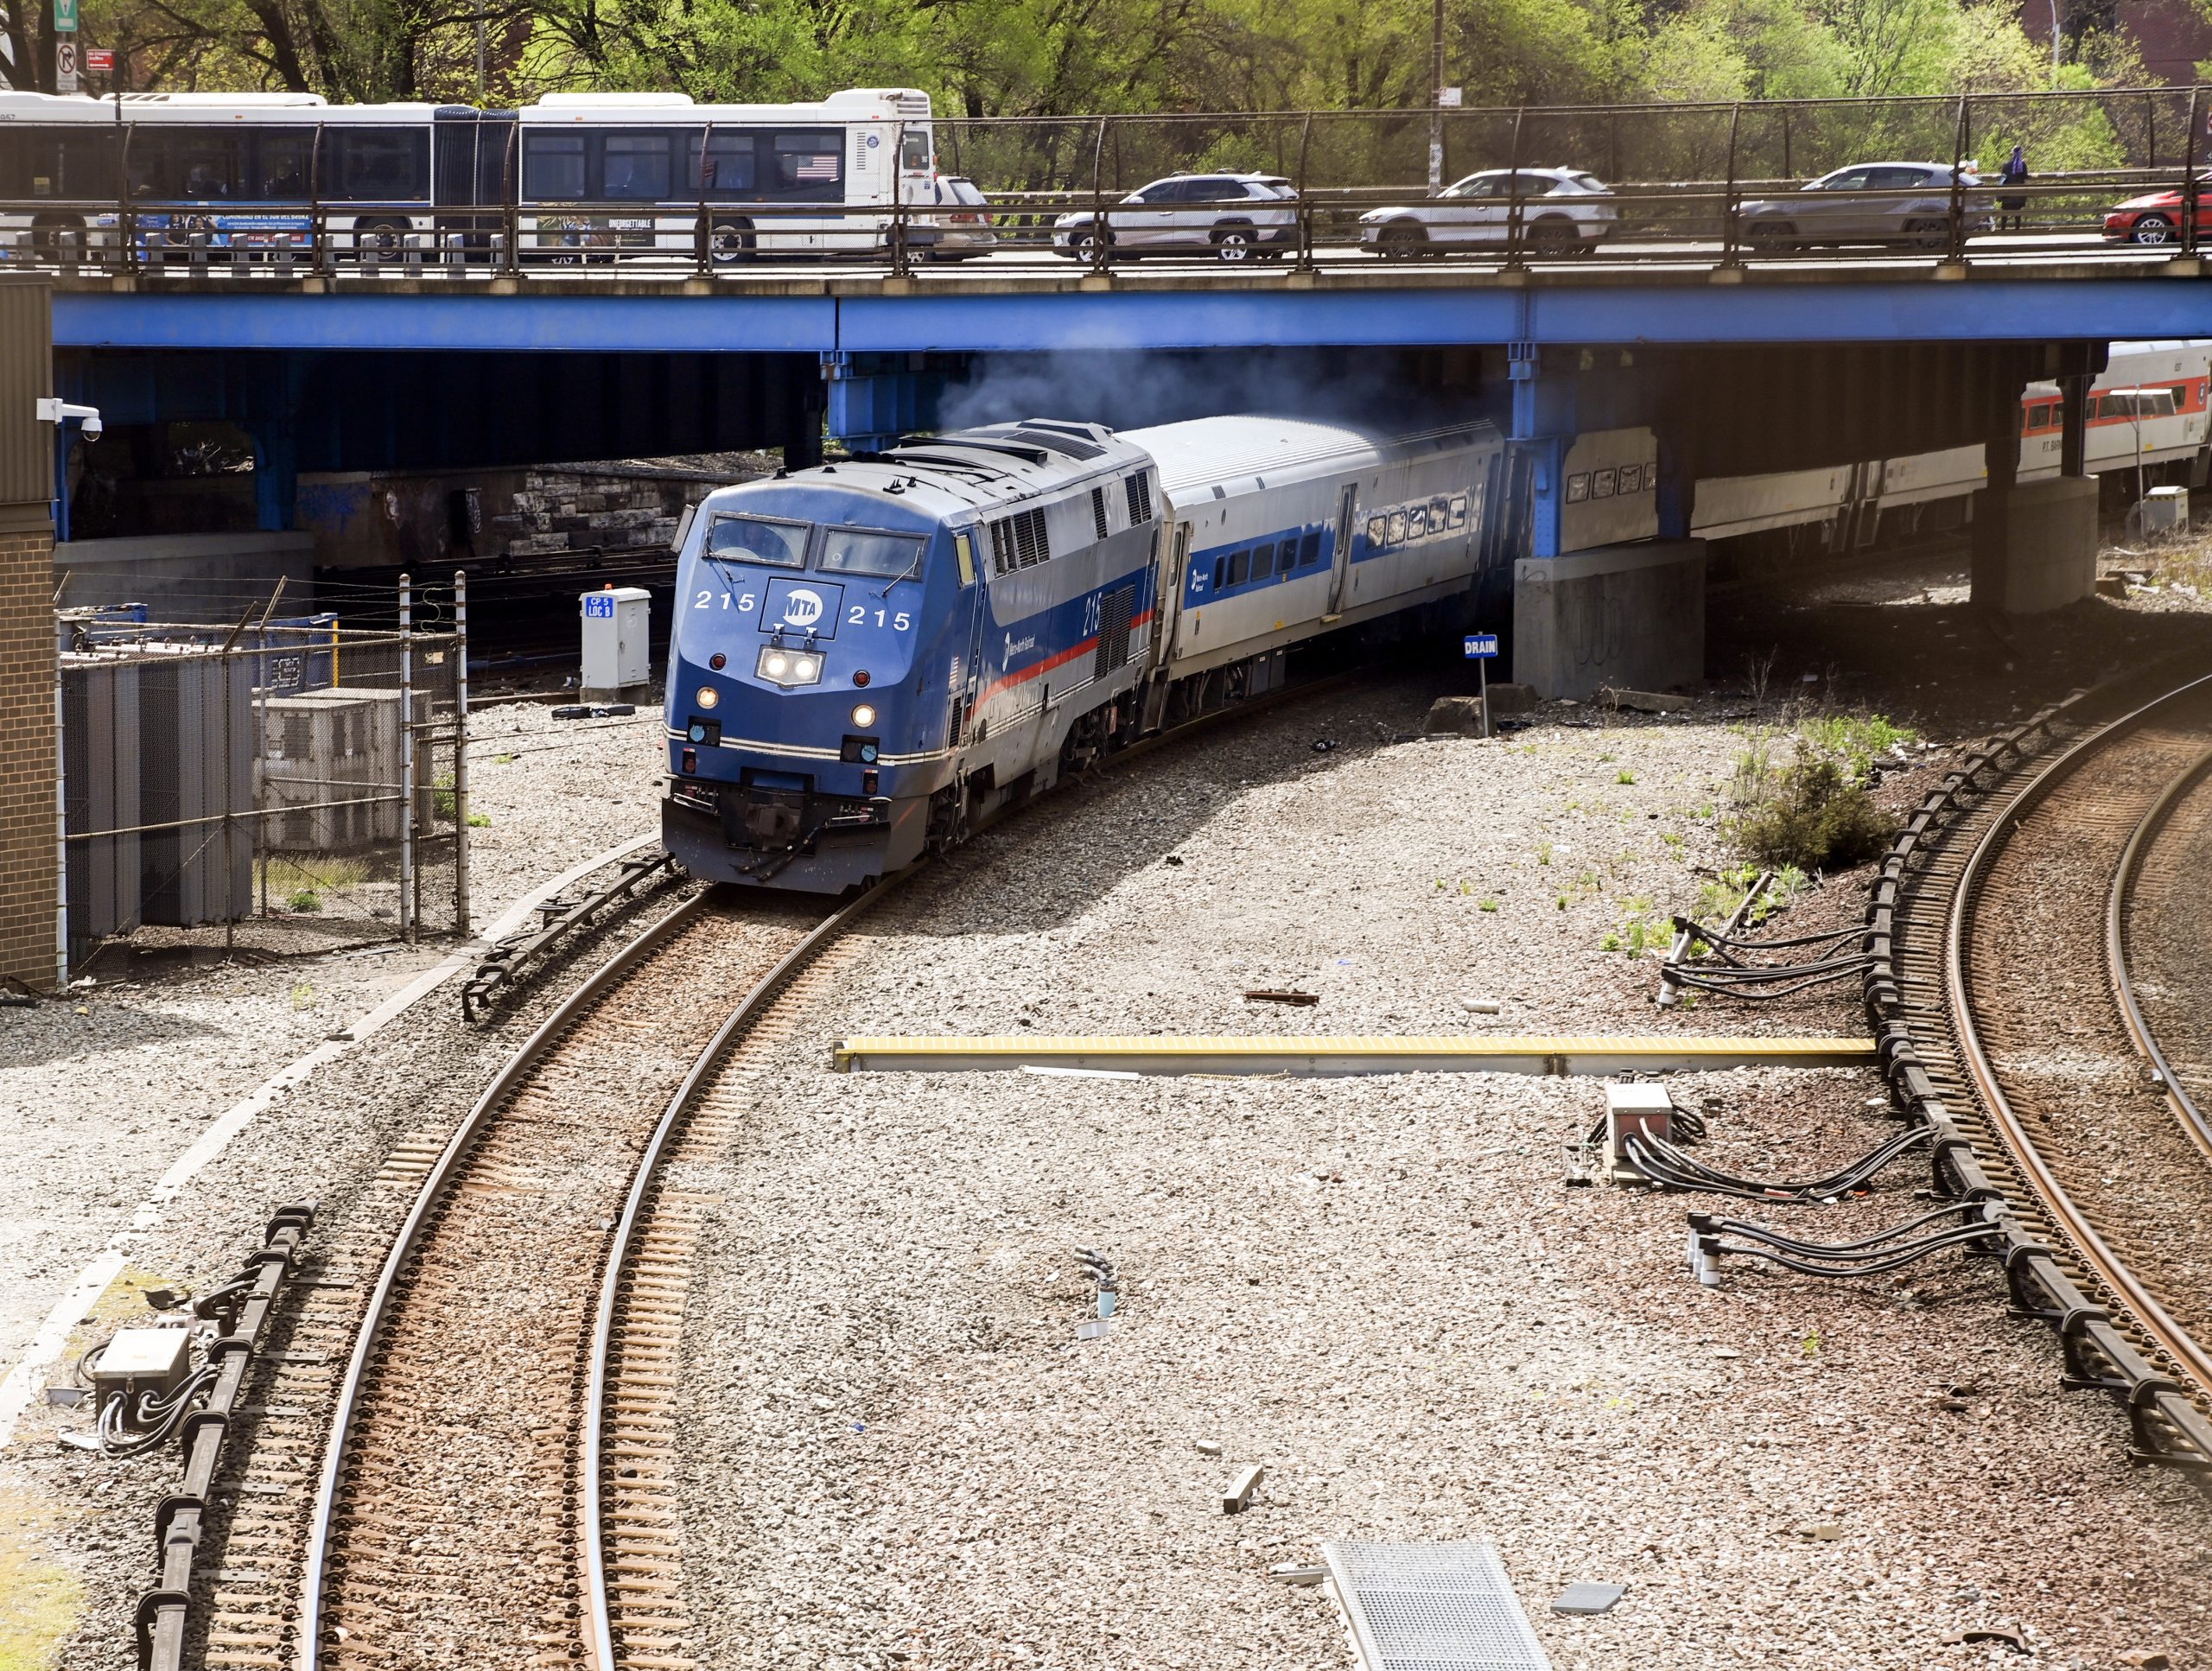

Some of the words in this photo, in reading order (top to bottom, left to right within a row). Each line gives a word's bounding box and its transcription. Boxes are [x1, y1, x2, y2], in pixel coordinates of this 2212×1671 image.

[608, 219, 652, 228] UNFORGETTABLE
[590, 597, 601, 606] CP
[694, 590, 755, 612] 215
[785, 597, 817, 617] MTA
[588, 606, 602, 617] LOC
[605, 607, 611, 617] B
[848, 606, 911, 632] 215
[1082, 591, 1103, 637] 215
[1465, 640, 1496, 654] DRAIN
